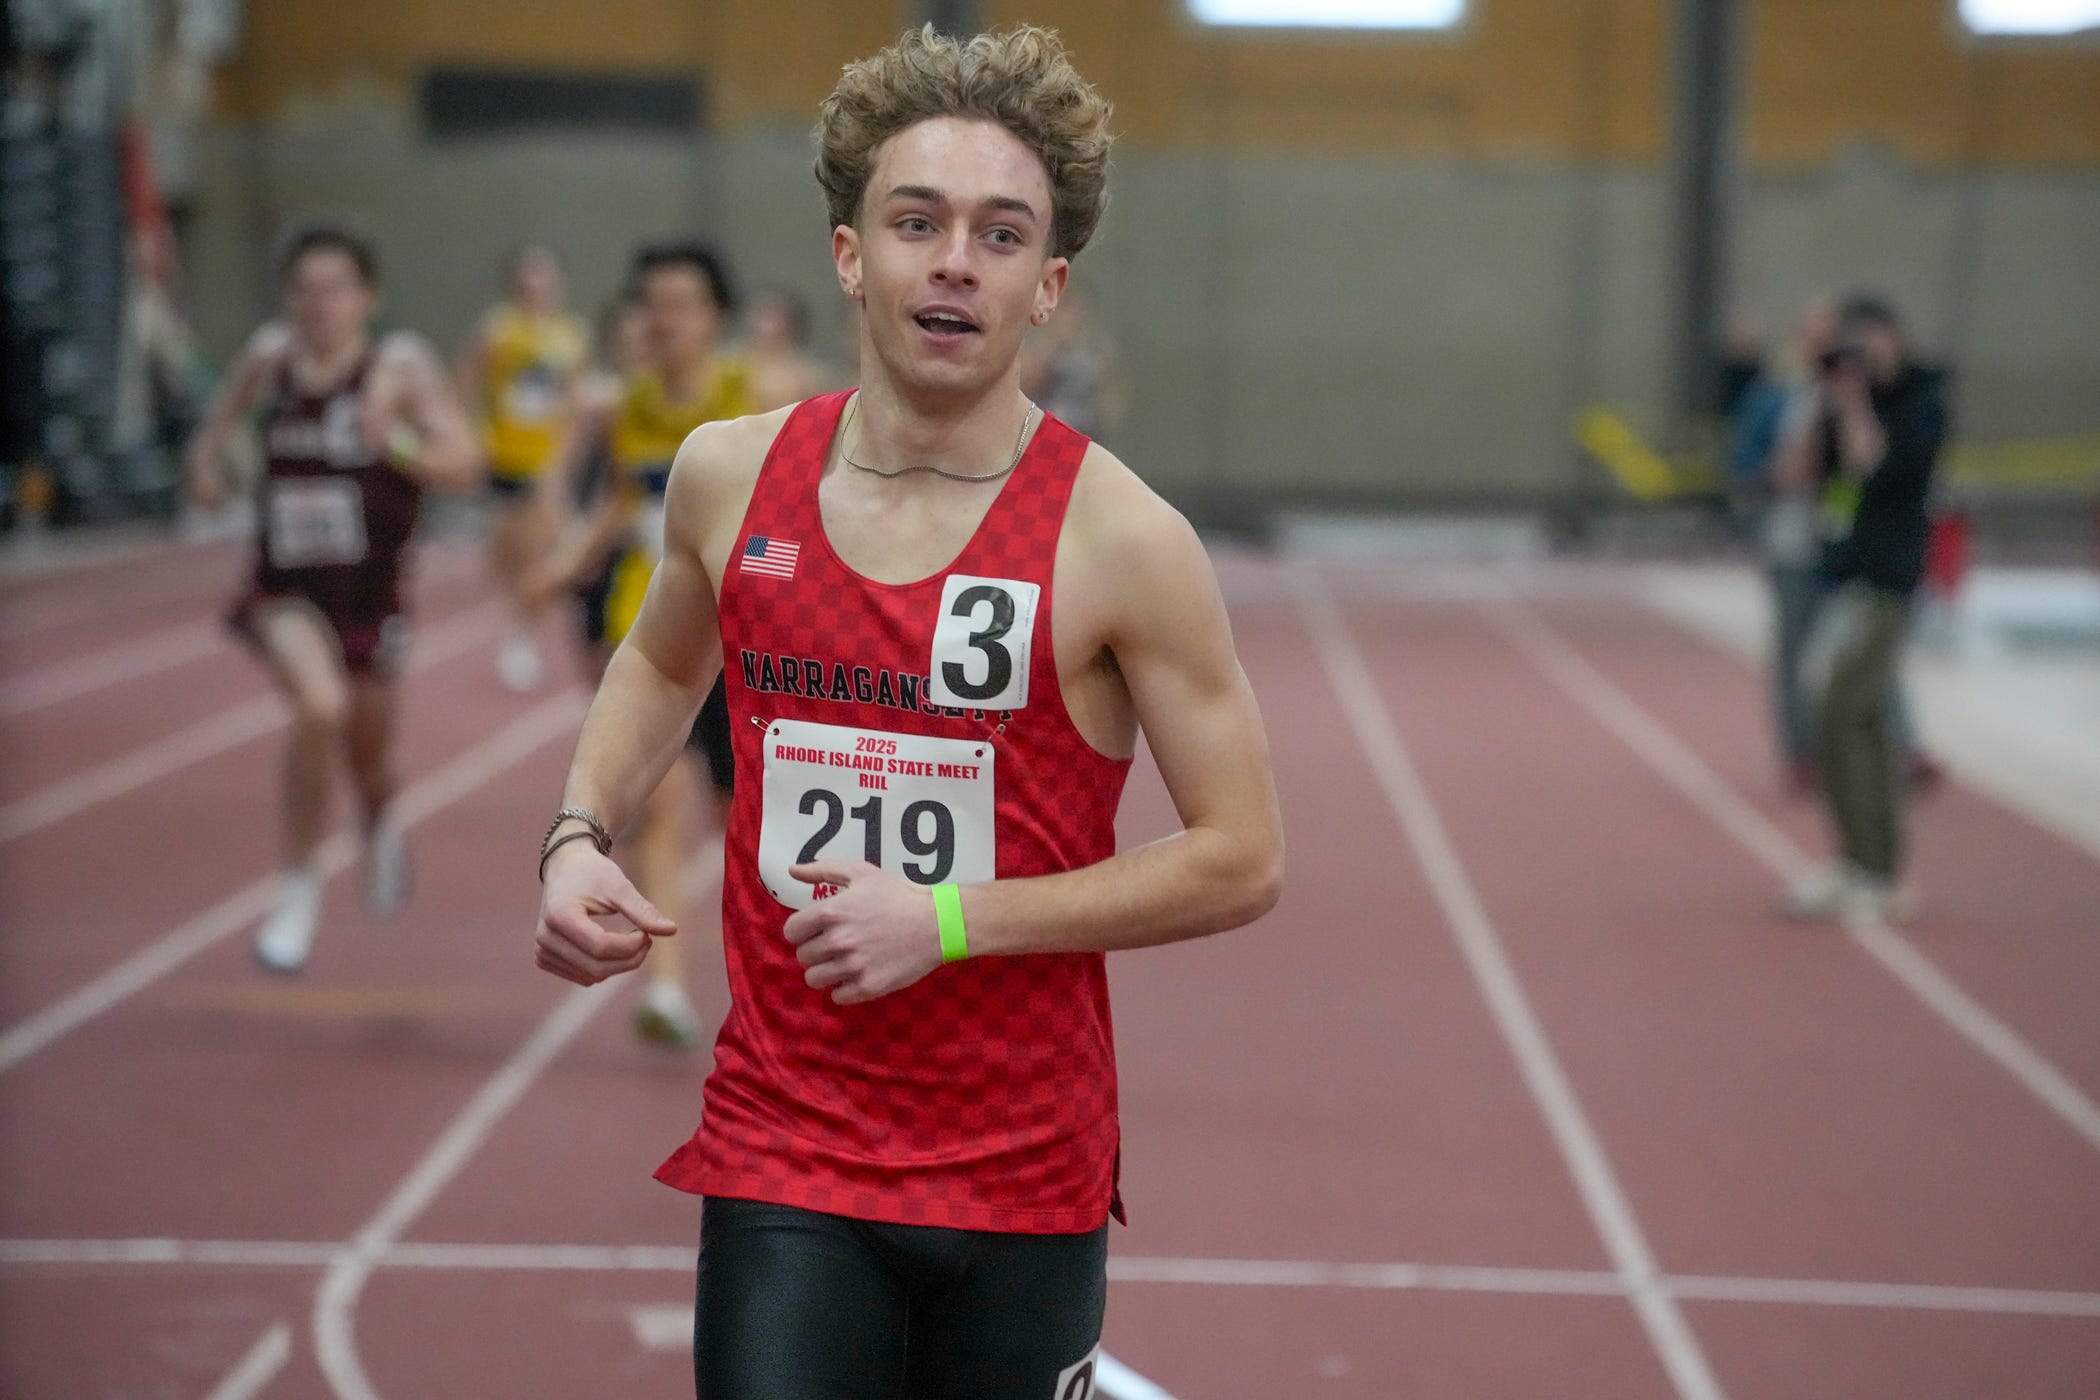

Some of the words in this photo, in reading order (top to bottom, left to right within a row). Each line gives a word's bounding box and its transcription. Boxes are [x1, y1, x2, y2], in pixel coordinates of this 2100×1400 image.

[942, 585, 1016, 701] 3
[740, 648, 1013, 721] NARRAGANS
[775, 744, 825, 765] RHODE
[829, 751, 884, 772] ISLAND
[887, 758, 934, 777] STATE
[938, 763, 980, 780] MEET
[856, 736, 897, 755] 2025
[859, 773, 888, 791] RIIL
[796, 788, 955, 886] 219
